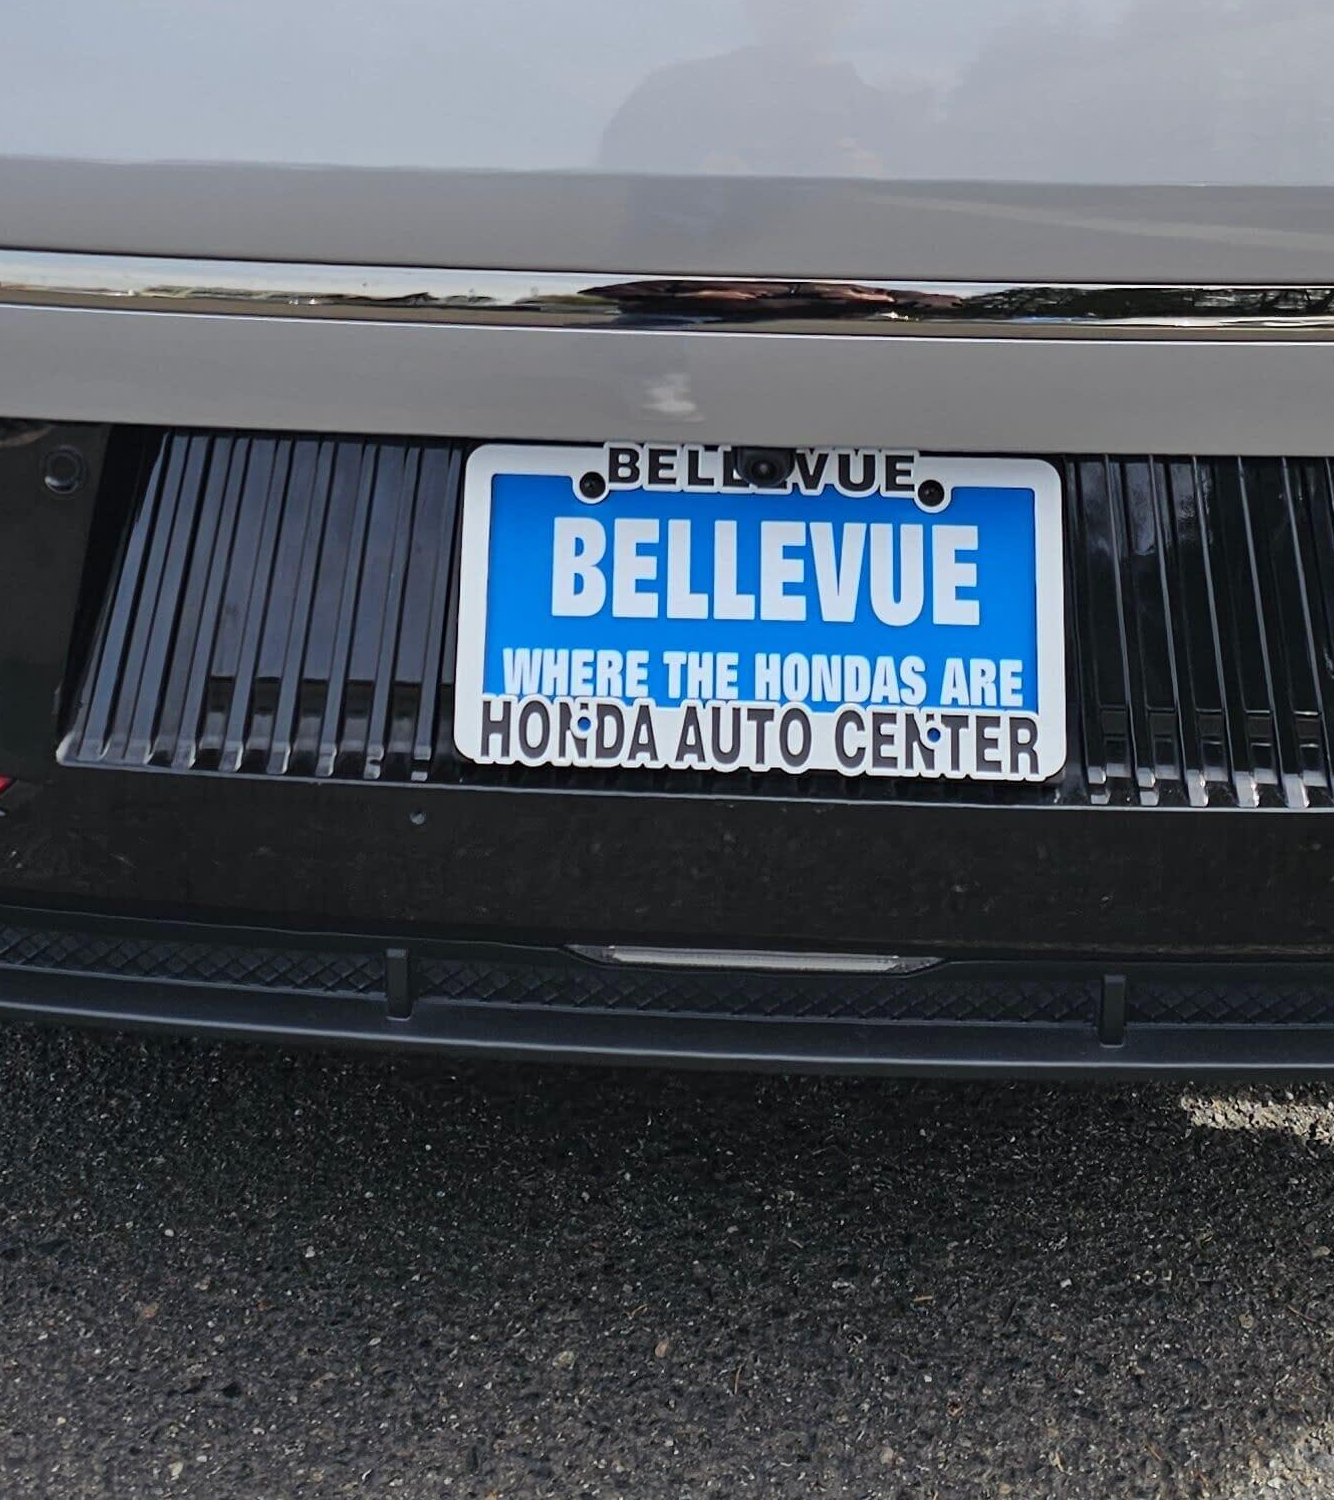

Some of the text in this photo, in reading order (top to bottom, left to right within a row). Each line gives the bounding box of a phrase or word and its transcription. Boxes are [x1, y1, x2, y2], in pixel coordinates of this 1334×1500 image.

[608, 447, 916, 492] BELLVUE
[551, 516, 980, 626] BELLEVUE
[503, 647, 1023, 707] WHERE THE HONDAS ARE
[480, 699, 1040, 775] HONDA AUTO CENTER
